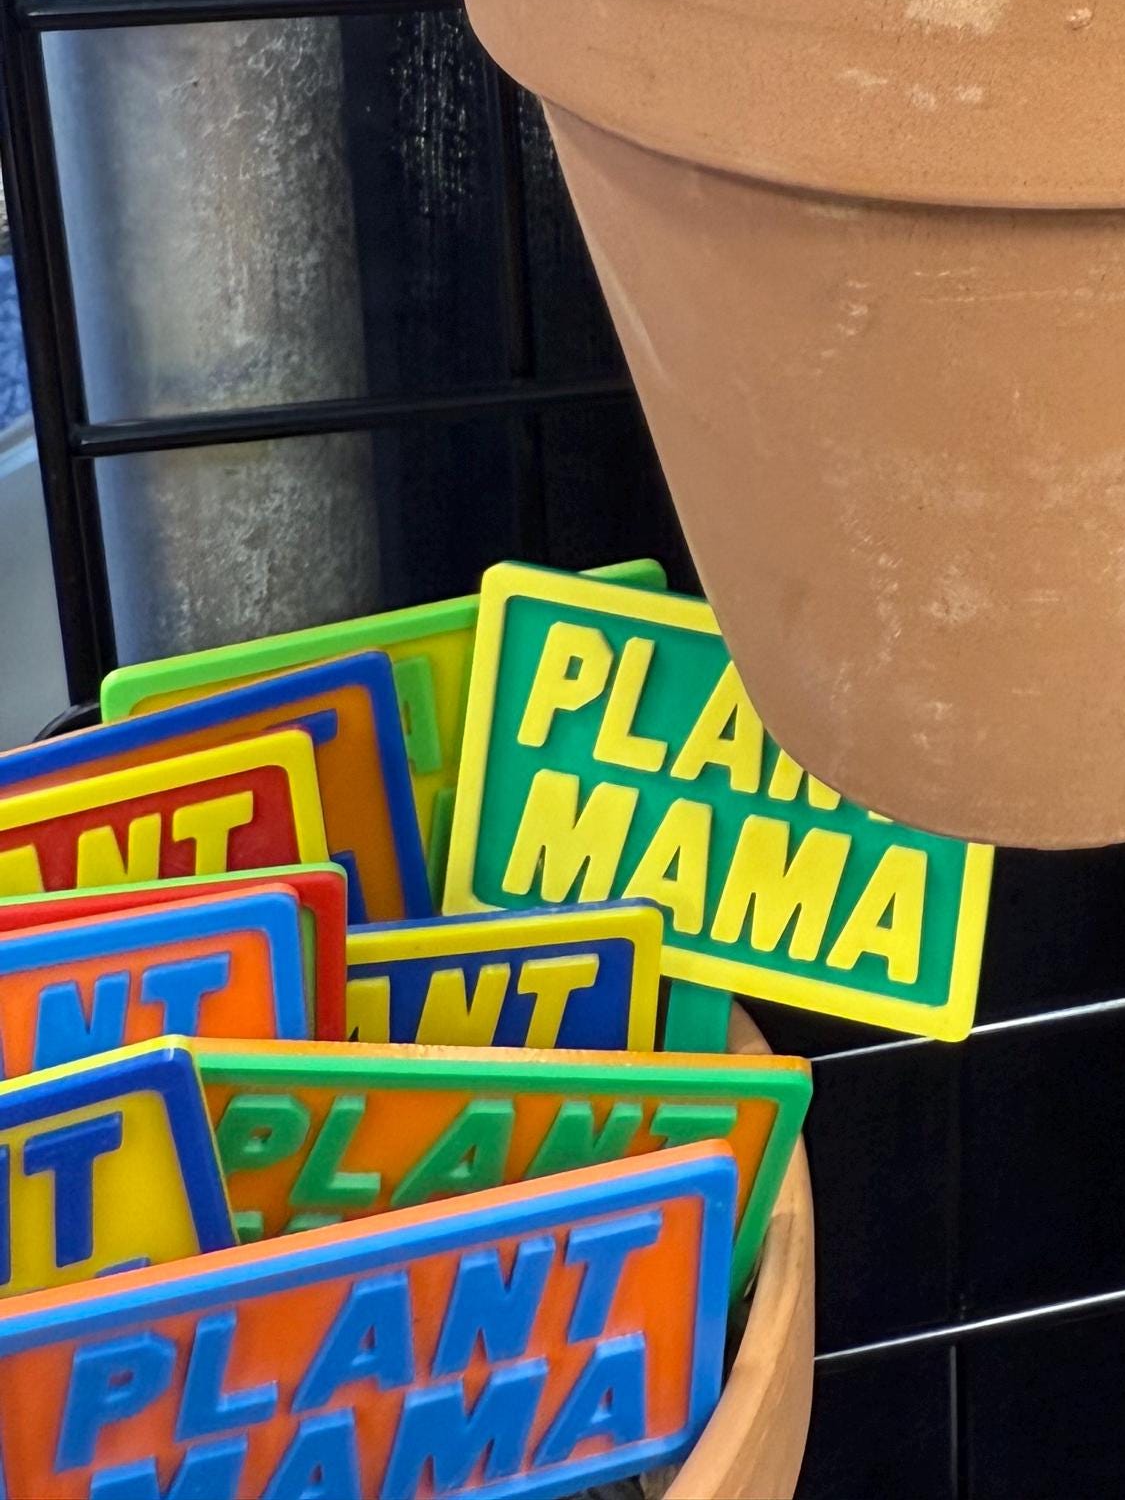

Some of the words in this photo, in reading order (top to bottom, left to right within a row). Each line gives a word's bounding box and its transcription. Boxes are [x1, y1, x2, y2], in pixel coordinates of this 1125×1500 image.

[517, 621, 893, 823] PLA
[0, 790, 253, 897] NT
[502, 768, 928, 985] MAMA
[0, 951, 231, 1078] NT
[55, 1210, 662, 1475] PLANT
